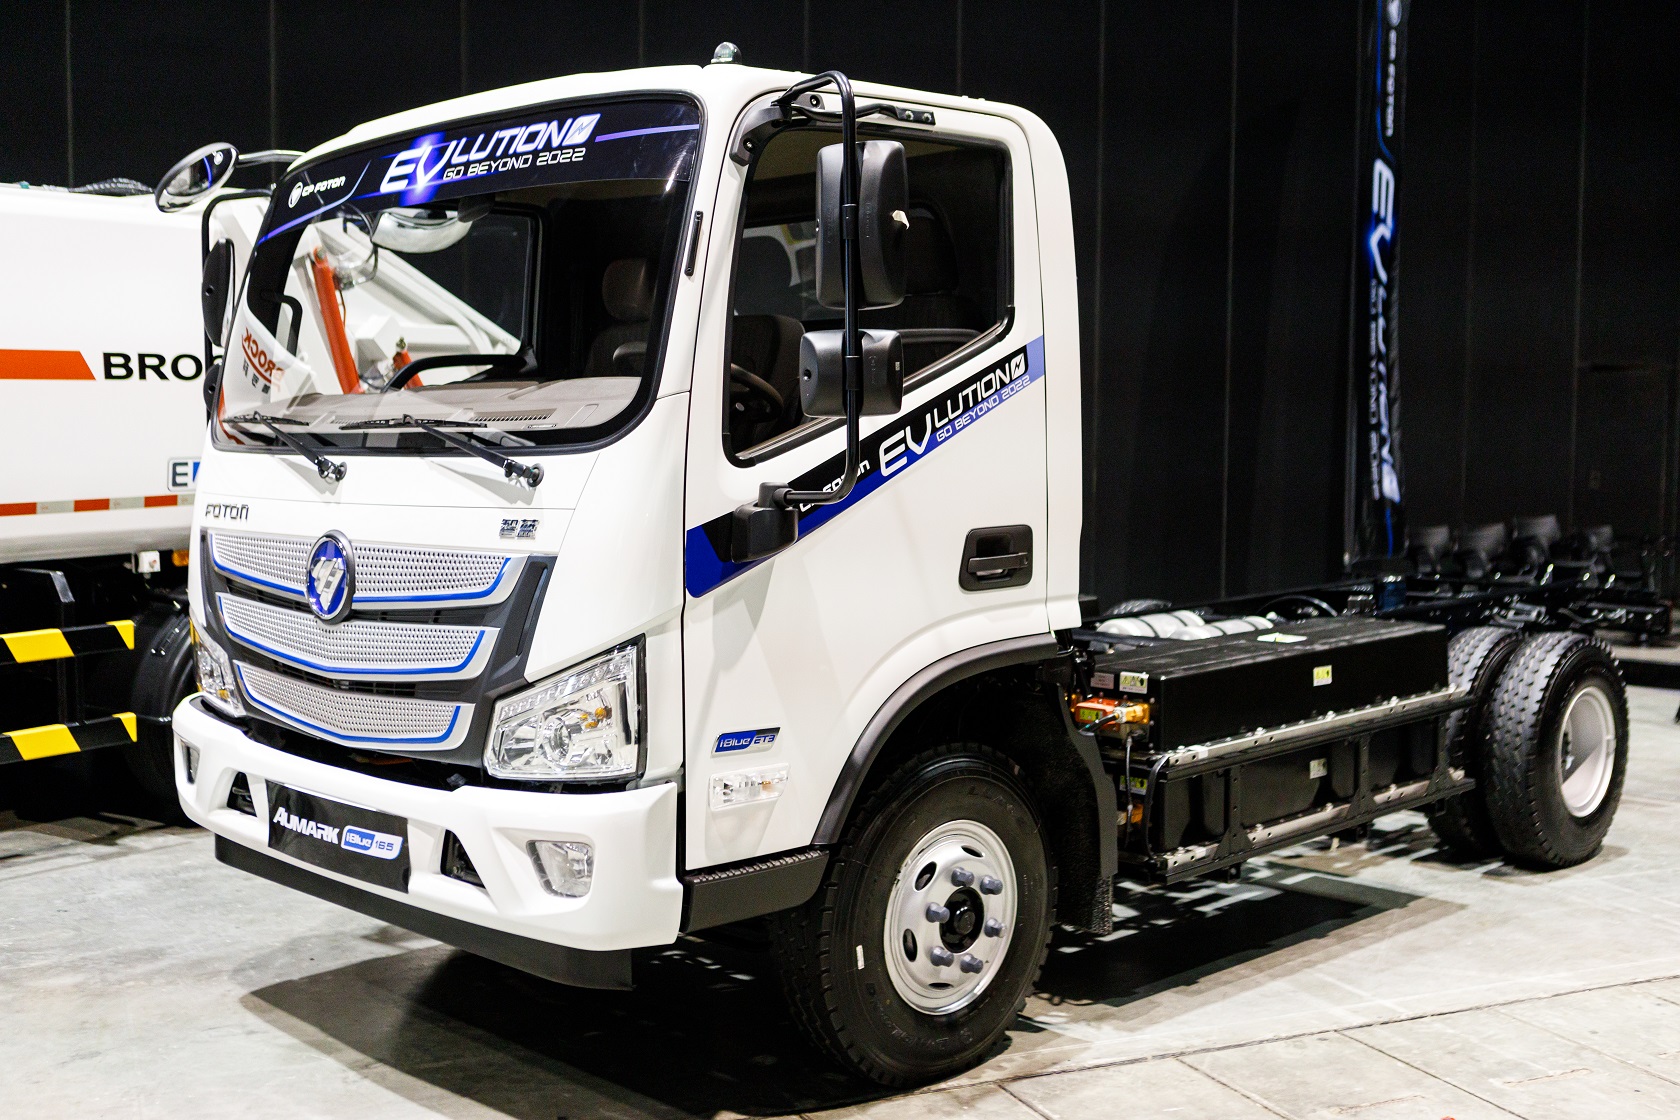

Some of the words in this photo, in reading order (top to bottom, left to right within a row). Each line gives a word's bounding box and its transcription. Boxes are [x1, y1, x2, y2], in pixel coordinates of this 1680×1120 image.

[443, 167, 464, 181] GO
[467, 153, 532, 177] BEYOND
[536, 147, 586, 166] 2022
[936, 427, 953, 442] GO
[955, 394, 1000, 430] BEYOND
[1001, 374, 1031, 400] 2022
[205, 503, 249, 521] FOTON
[273, 806, 340, 845] AUMARK
[345, 832, 372, 848] iBlue
